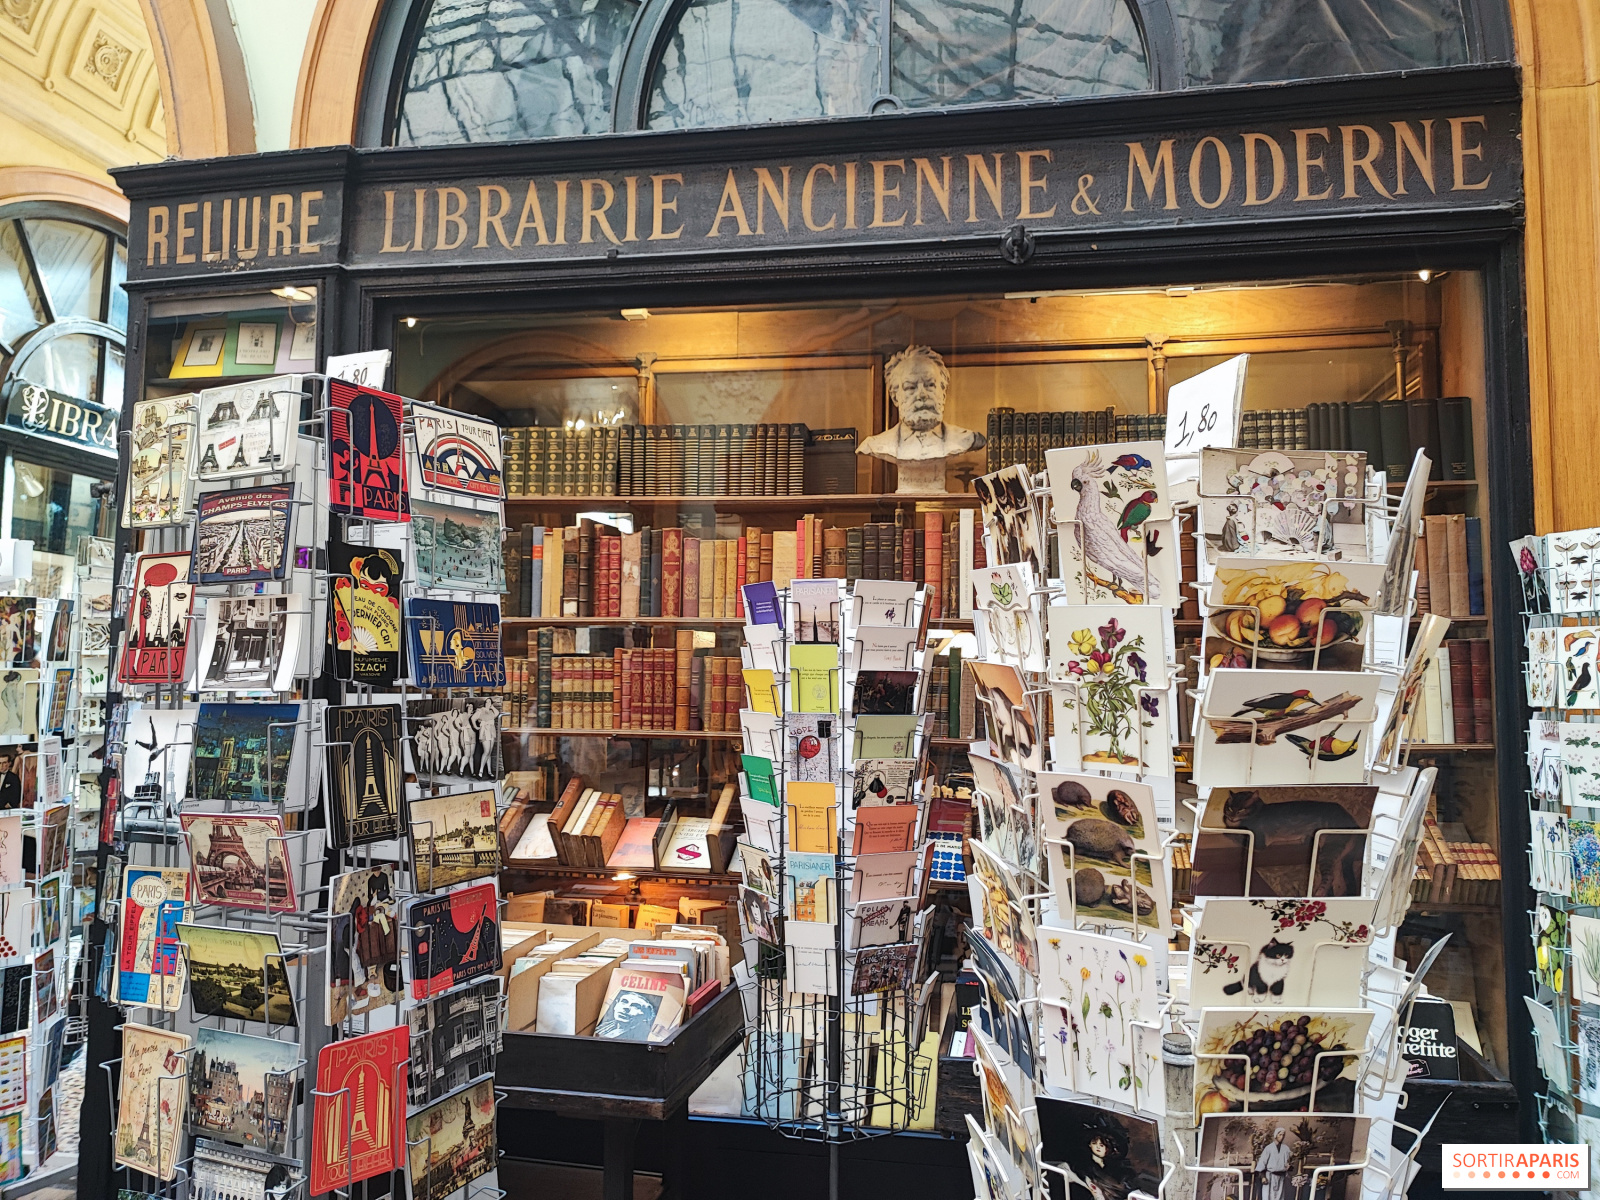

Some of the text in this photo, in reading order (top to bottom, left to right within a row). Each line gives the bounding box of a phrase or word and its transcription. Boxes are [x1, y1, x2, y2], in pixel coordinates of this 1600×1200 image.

[379, 115, 1492, 254] LIBRAIRIE ANCIENNE & MODERNE
[147, 191, 323, 267] RELIURE
[1174, 403, 1218, 448] 1,80
[201, 500, 287, 516] CHAMPS-ELYSES
[218, 494, 253, 504] Avenue
[363, 486, 407, 513] PARIS
[139, 651, 179, 674] PARS
[354, 663, 386, 672] SZACH
[344, 709, 389, 728] PARIS
[789, 861, 831, 871] PARISIANER
[137, 884, 162, 899] PARIS
[423, 904, 440, 917] PARIS
[1398, 1026, 1439, 1043] oger
[335, 1036, 389, 1068] PARIS
